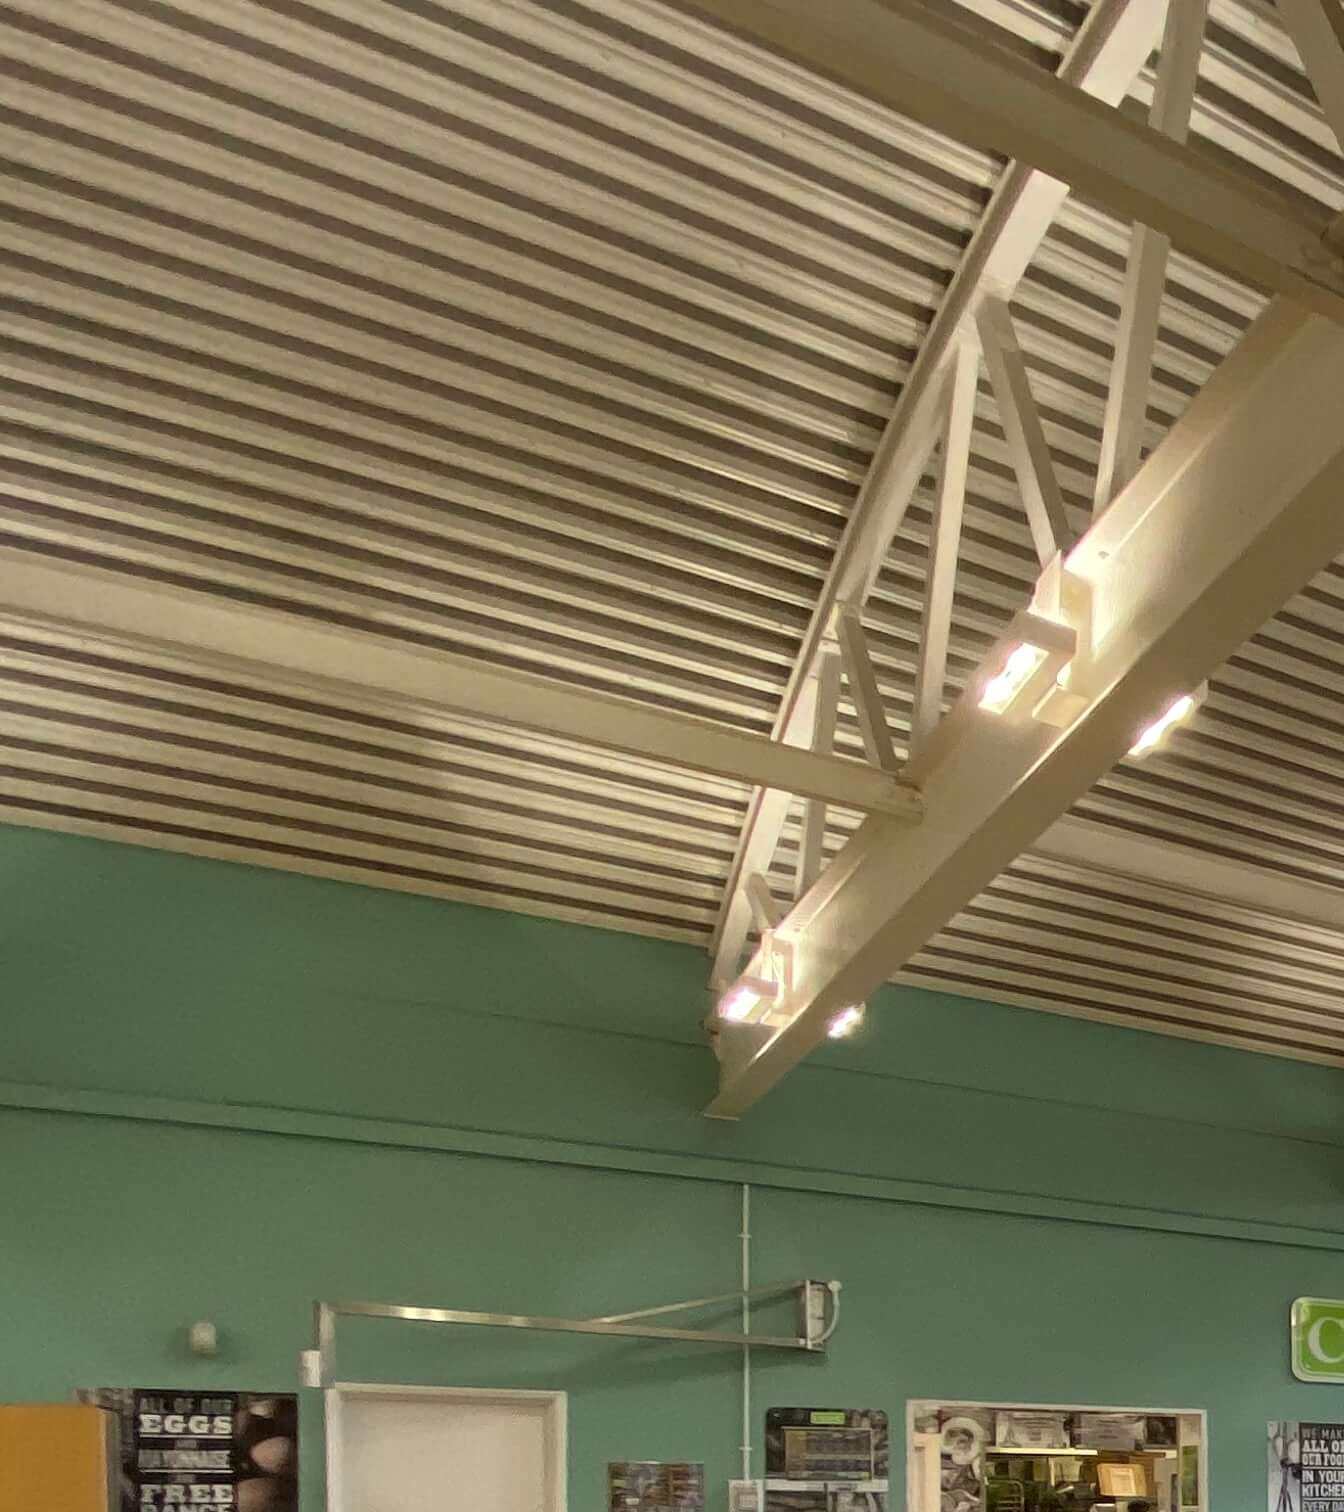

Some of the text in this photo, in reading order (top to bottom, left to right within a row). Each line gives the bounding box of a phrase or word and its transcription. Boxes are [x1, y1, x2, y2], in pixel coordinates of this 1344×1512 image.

[139, 1414, 233, 1434] EGGS
[1301, 1440, 1329, 1452] ALL
[1302, 1454, 1322, 1466] OUR
[1302, 1470, 1314, 1483] IN
[140, 1484, 233, 1503] FREE
[1302, 1502, 1330, 1512] EVERY
